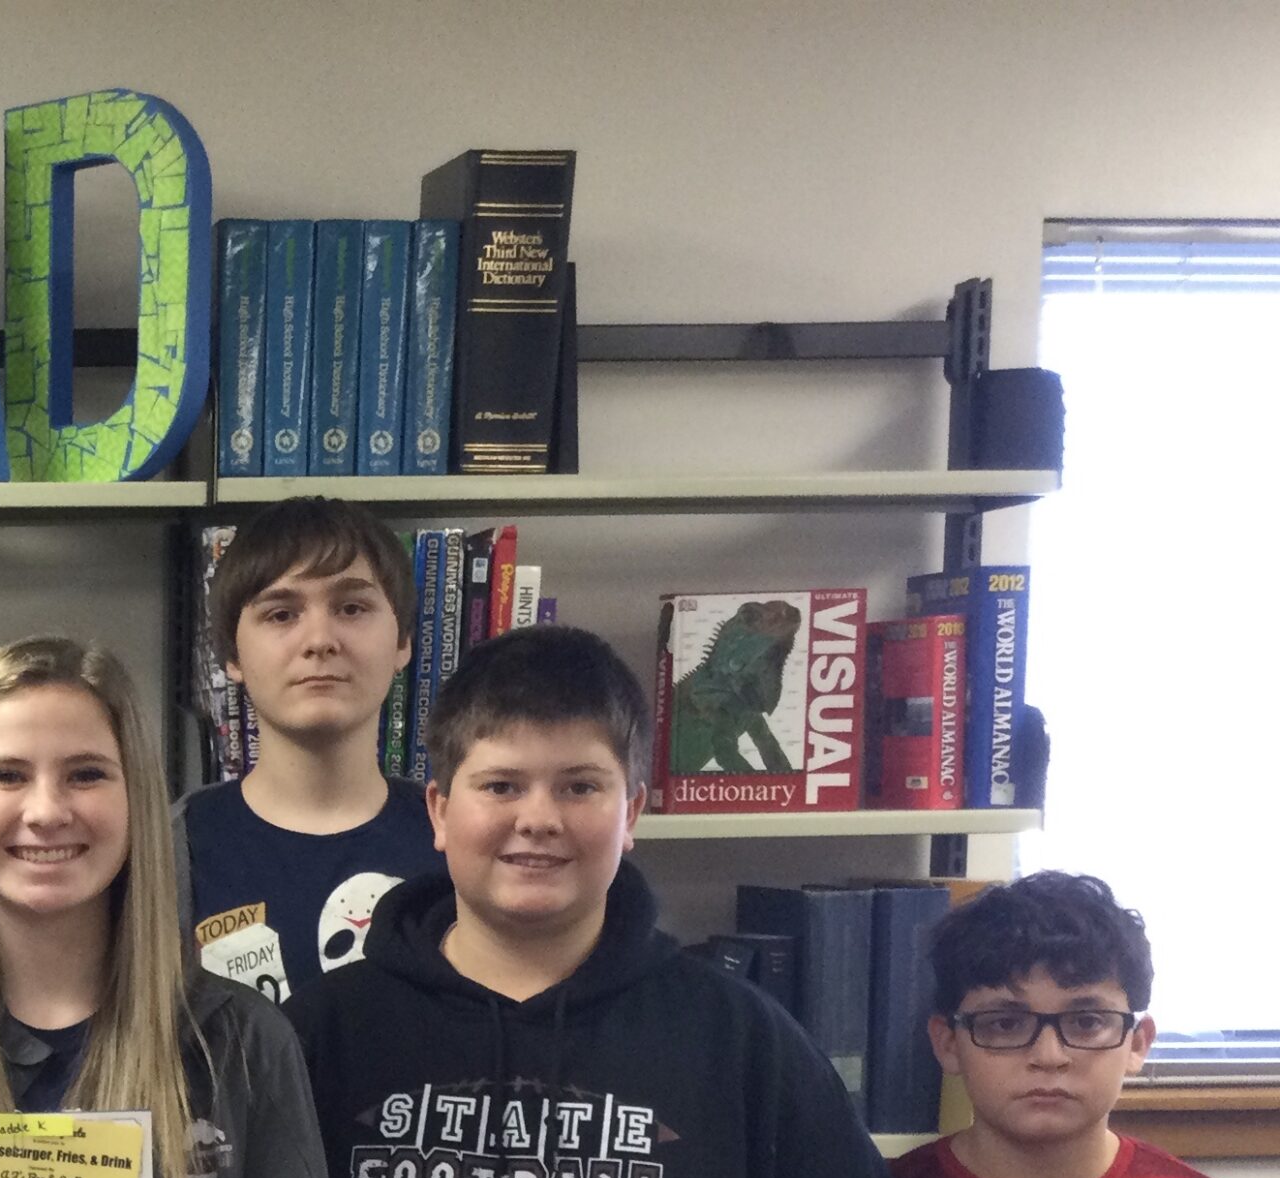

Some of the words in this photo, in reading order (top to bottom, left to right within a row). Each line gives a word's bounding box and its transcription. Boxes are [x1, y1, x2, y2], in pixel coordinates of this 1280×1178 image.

[477, 257, 554, 273] International
[482, 244, 518, 260] Third
[520, 245, 551, 260] New
[482, 271, 547, 288] Dictionary
[423, 538, 439, 615] GUINNESS
[444, 534, 460, 613] GUINNESS
[988, 574, 1026, 593] 2012
[517, 586, 534, 625] HINTS
[420, 619, 436, 674] WORLD
[440, 614, 455, 671] WORLD
[995, 608, 1017, 684] WORLD
[805, 600, 858, 805] VISUAL
[942, 649, 958, 711] WORLD
[416, 678, 431, 747] RECORDS
[990, 686, 1015, 785] ALMANAC
[939, 711, 958, 787] ALMANAC
[674, 780, 797, 807] dictionary
[199, 906, 259, 943] TODAY
[226, 943, 276, 979] FRIDAY
[37, 1119, 47, 1131] K
[380, 1093, 655, 1155] STATE
[89, 1156, 98, 1166] &
[100, 1155, 133, 1170] Drink
